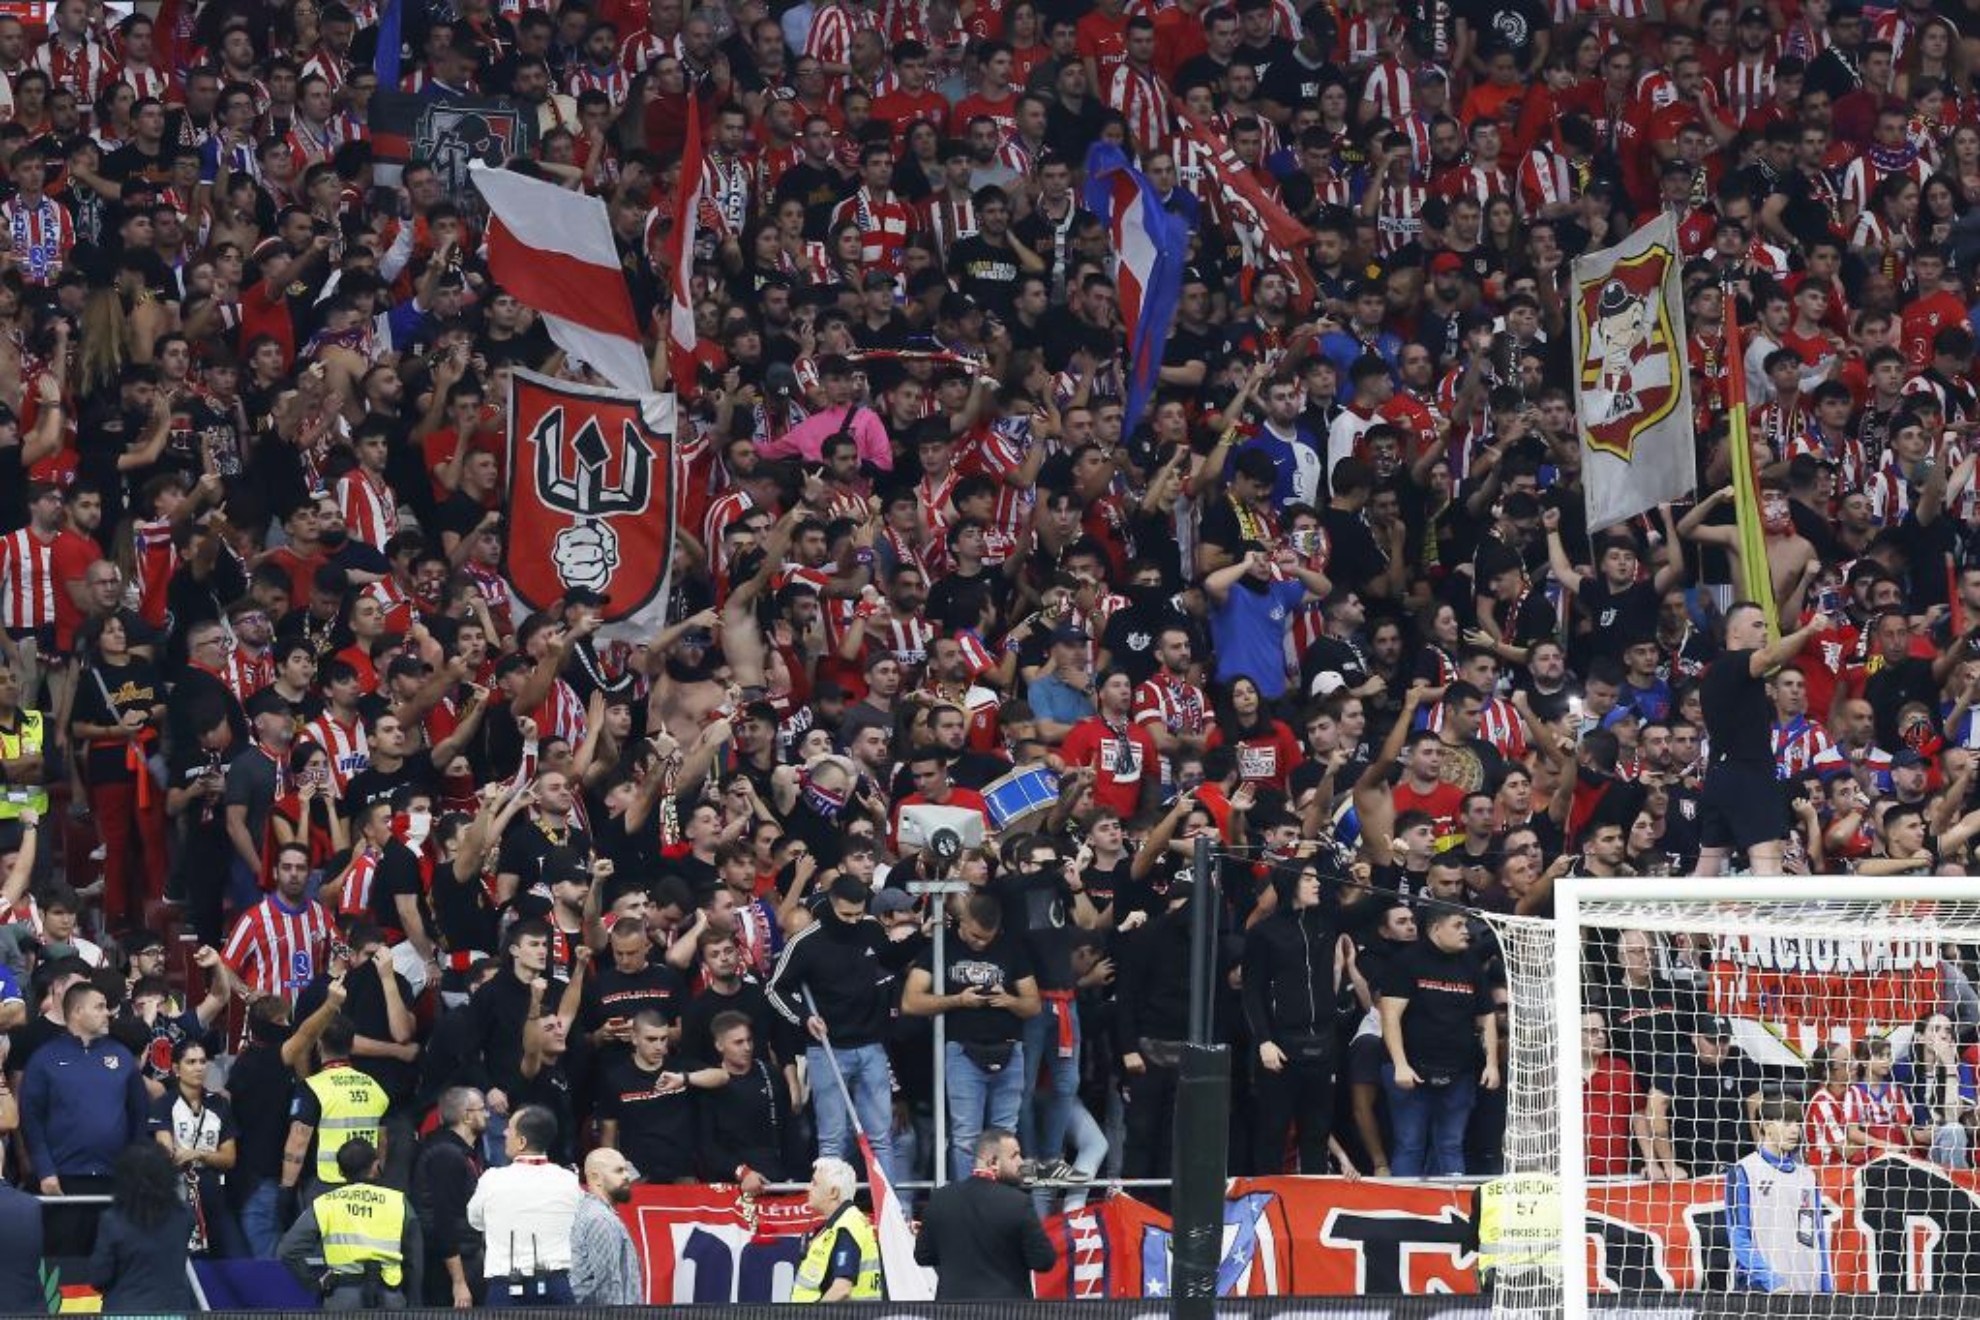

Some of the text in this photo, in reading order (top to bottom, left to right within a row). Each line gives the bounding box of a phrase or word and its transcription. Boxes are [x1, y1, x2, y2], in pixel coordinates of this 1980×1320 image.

[348, 1089, 369, 1102] 353
[346, 1202, 373, 1219] 1011
[757, 1201, 814, 1218] LÉTIC
